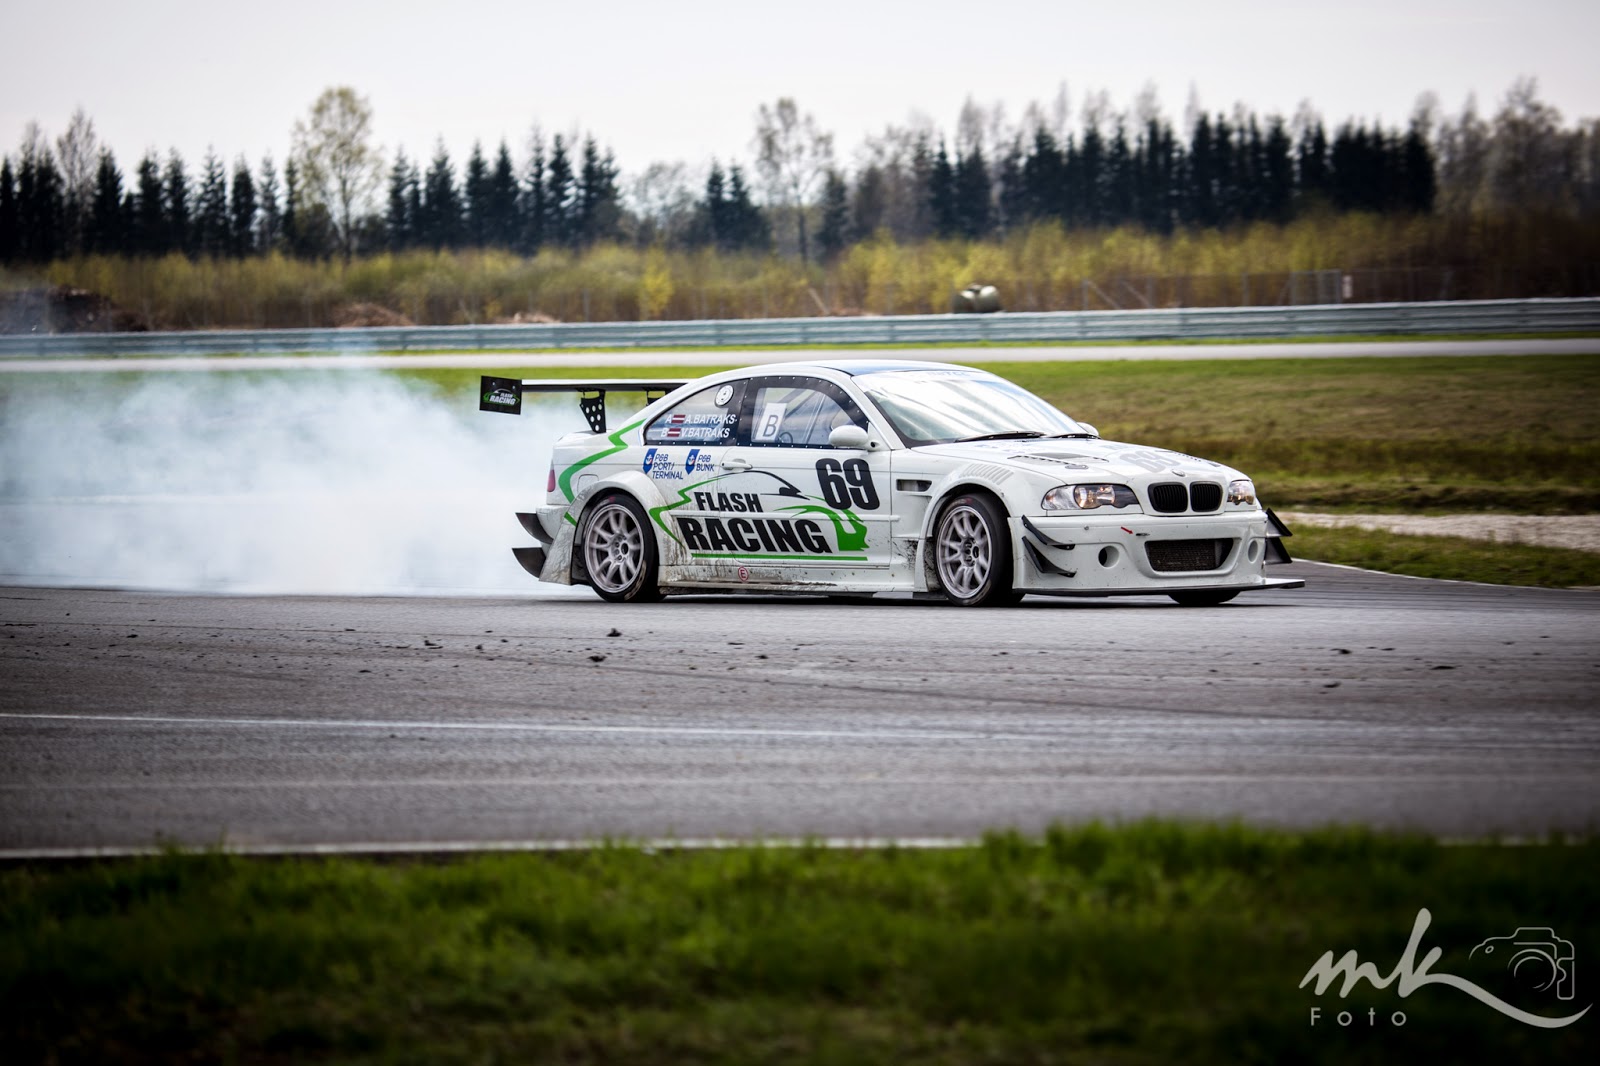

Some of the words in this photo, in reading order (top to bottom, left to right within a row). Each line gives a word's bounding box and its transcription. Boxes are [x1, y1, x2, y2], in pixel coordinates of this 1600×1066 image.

[490, 395, 516, 405] RACING
[665, 414, 672, 424] A
[763, 414, 778, 437] B
[661, 427, 668, 438] B
[681, 428, 730, 438] V.BATRAKS
[696, 463, 715, 472] BUNK
[1120, 451, 1181, 474] 69
[652, 471, 683, 480] TERMINAL
[815, 457, 880, 511] 69
[694, 491, 763, 513] FLASH
[676, 517, 832, 554] RACING
